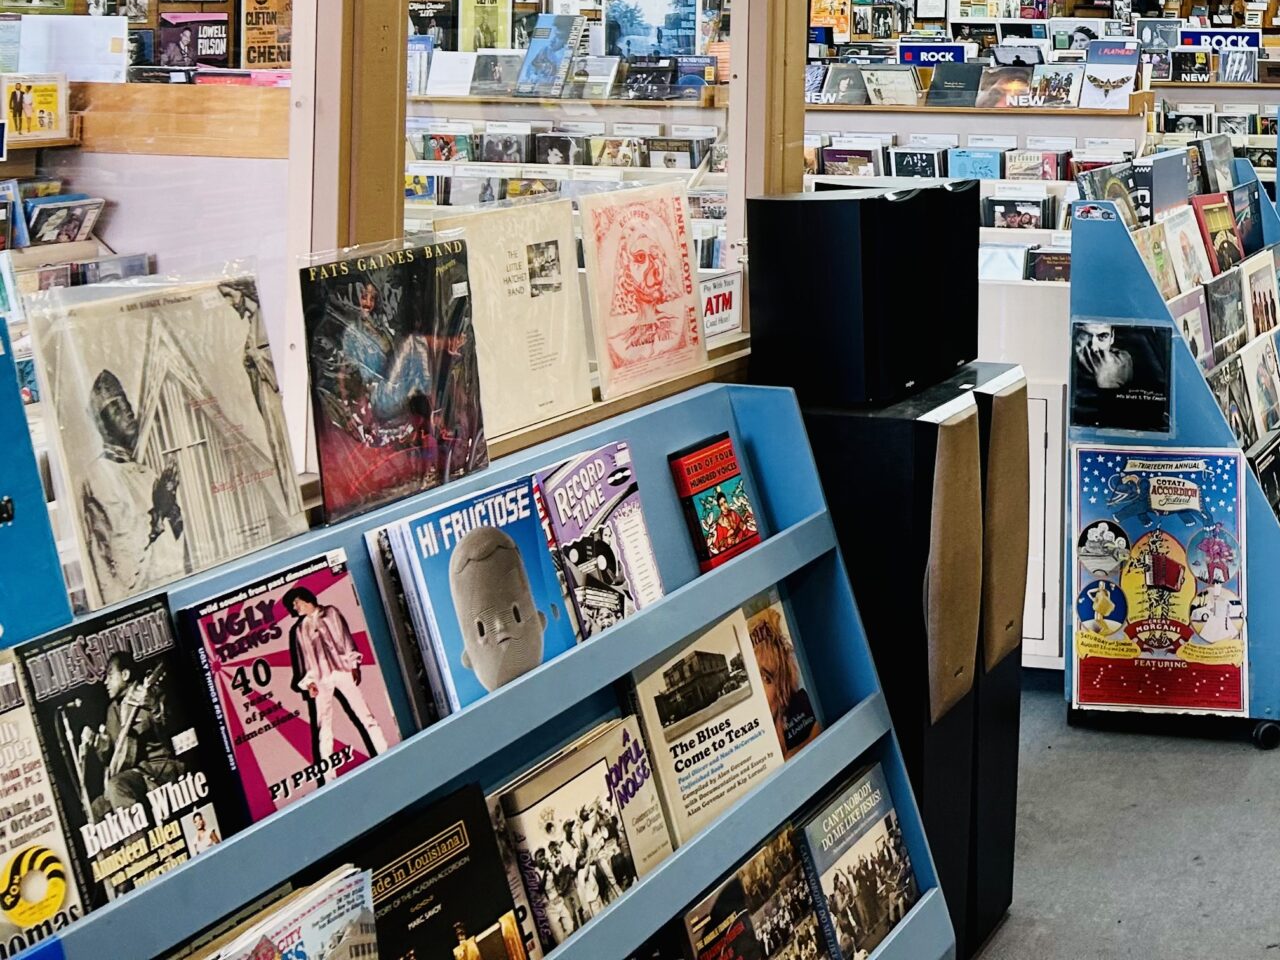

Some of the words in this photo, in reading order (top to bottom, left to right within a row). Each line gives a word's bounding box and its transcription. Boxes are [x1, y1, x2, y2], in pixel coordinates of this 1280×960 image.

[198, 26, 227, 38] LOWELL
[246, 11, 278, 26] CLIFTON
[197, 38, 227, 56] FULSON
[920, 51, 955, 62] ROCK
[1200, 35, 1250, 50] ROCK
[1181, 73, 1210, 82] NEW
[1006, 96, 1045, 107] NEW
[674, 196, 687, 236] PINK
[309, 261, 349, 281] FATS
[357, 249, 415, 273] GAINES
[424, 240, 463, 259] BAND
[506, 261, 523, 273] LITTLE
[507, 250, 519, 259] THE
[680, 242, 693, 296] FLOYD
[507, 286, 525, 297] BAND
[703, 290, 733, 318] ATM
[688, 305, 699, 345] LIVE
[685, 461, 703, 476] BIRD
[715, 450, 734, 465] FOUR
[690, 470, 717, 490] HUNDRED
[717, 461, 738, 477] VOICES
[1175, 461, 1200, 470] ANNUAL
[553, 458, 606, 525] RECORD
[1151, 485, 1198, 498] ACCORDION
[1156, 478, 1186, 487] COTATI
[572, 486, 606, 529] TIME
[416, 521, 439, 559] HI
[438, 486, 533, 544] FRUCTOSE
[199, 602, 218, 617] wild
[219, 591, 248, 609] sounds
[248, 583, 268, 597] from
[268, 576, 285, 591] past
[285, 560, 329, 584] dimensions
[206, 598, 276, 645] UGLY
[1136, 623, 1181, 634] MORGANI
[198, 647, 210, 672] UGLY
[1134, 659, 1188, 669] FEATURING
[231, 657, 272, 697] 40
[243, 690, 275, 712] years
[245, 710, 258, 726] of
[259, 700, 283, 722] past
[234, 709, 301, 746] dimensions
[622, 727, 631, 748] A
[668, 737, 697, 759] The
[695, 716, 732, 743] Blues
[673, 748, 712, 774] Come
[711, 739, 726, 753] to
[725, 715, 761, 744] Texas
[268, 777, 291, 802] PJ
[291, 744, 354, 790] PROBY
[605, 737, 645, 802] JOYFUL
[616, 759, 651, 810] NOISE
[844, 780, 873, 815] NOBODY
[80, 801, 149, 858] Bukka
[146, 770, 210, 823] White
[371, 874, 392, 896] ade
[392, 868, 406, 884] in
[407, 833, 461, 876] Louisiana
[4, 874, 22, 907] RON
[407, 913, 424, 931] MARC
[424, 903, 442, 921] SAVOY
[277, 926, 302, 952] CITY
